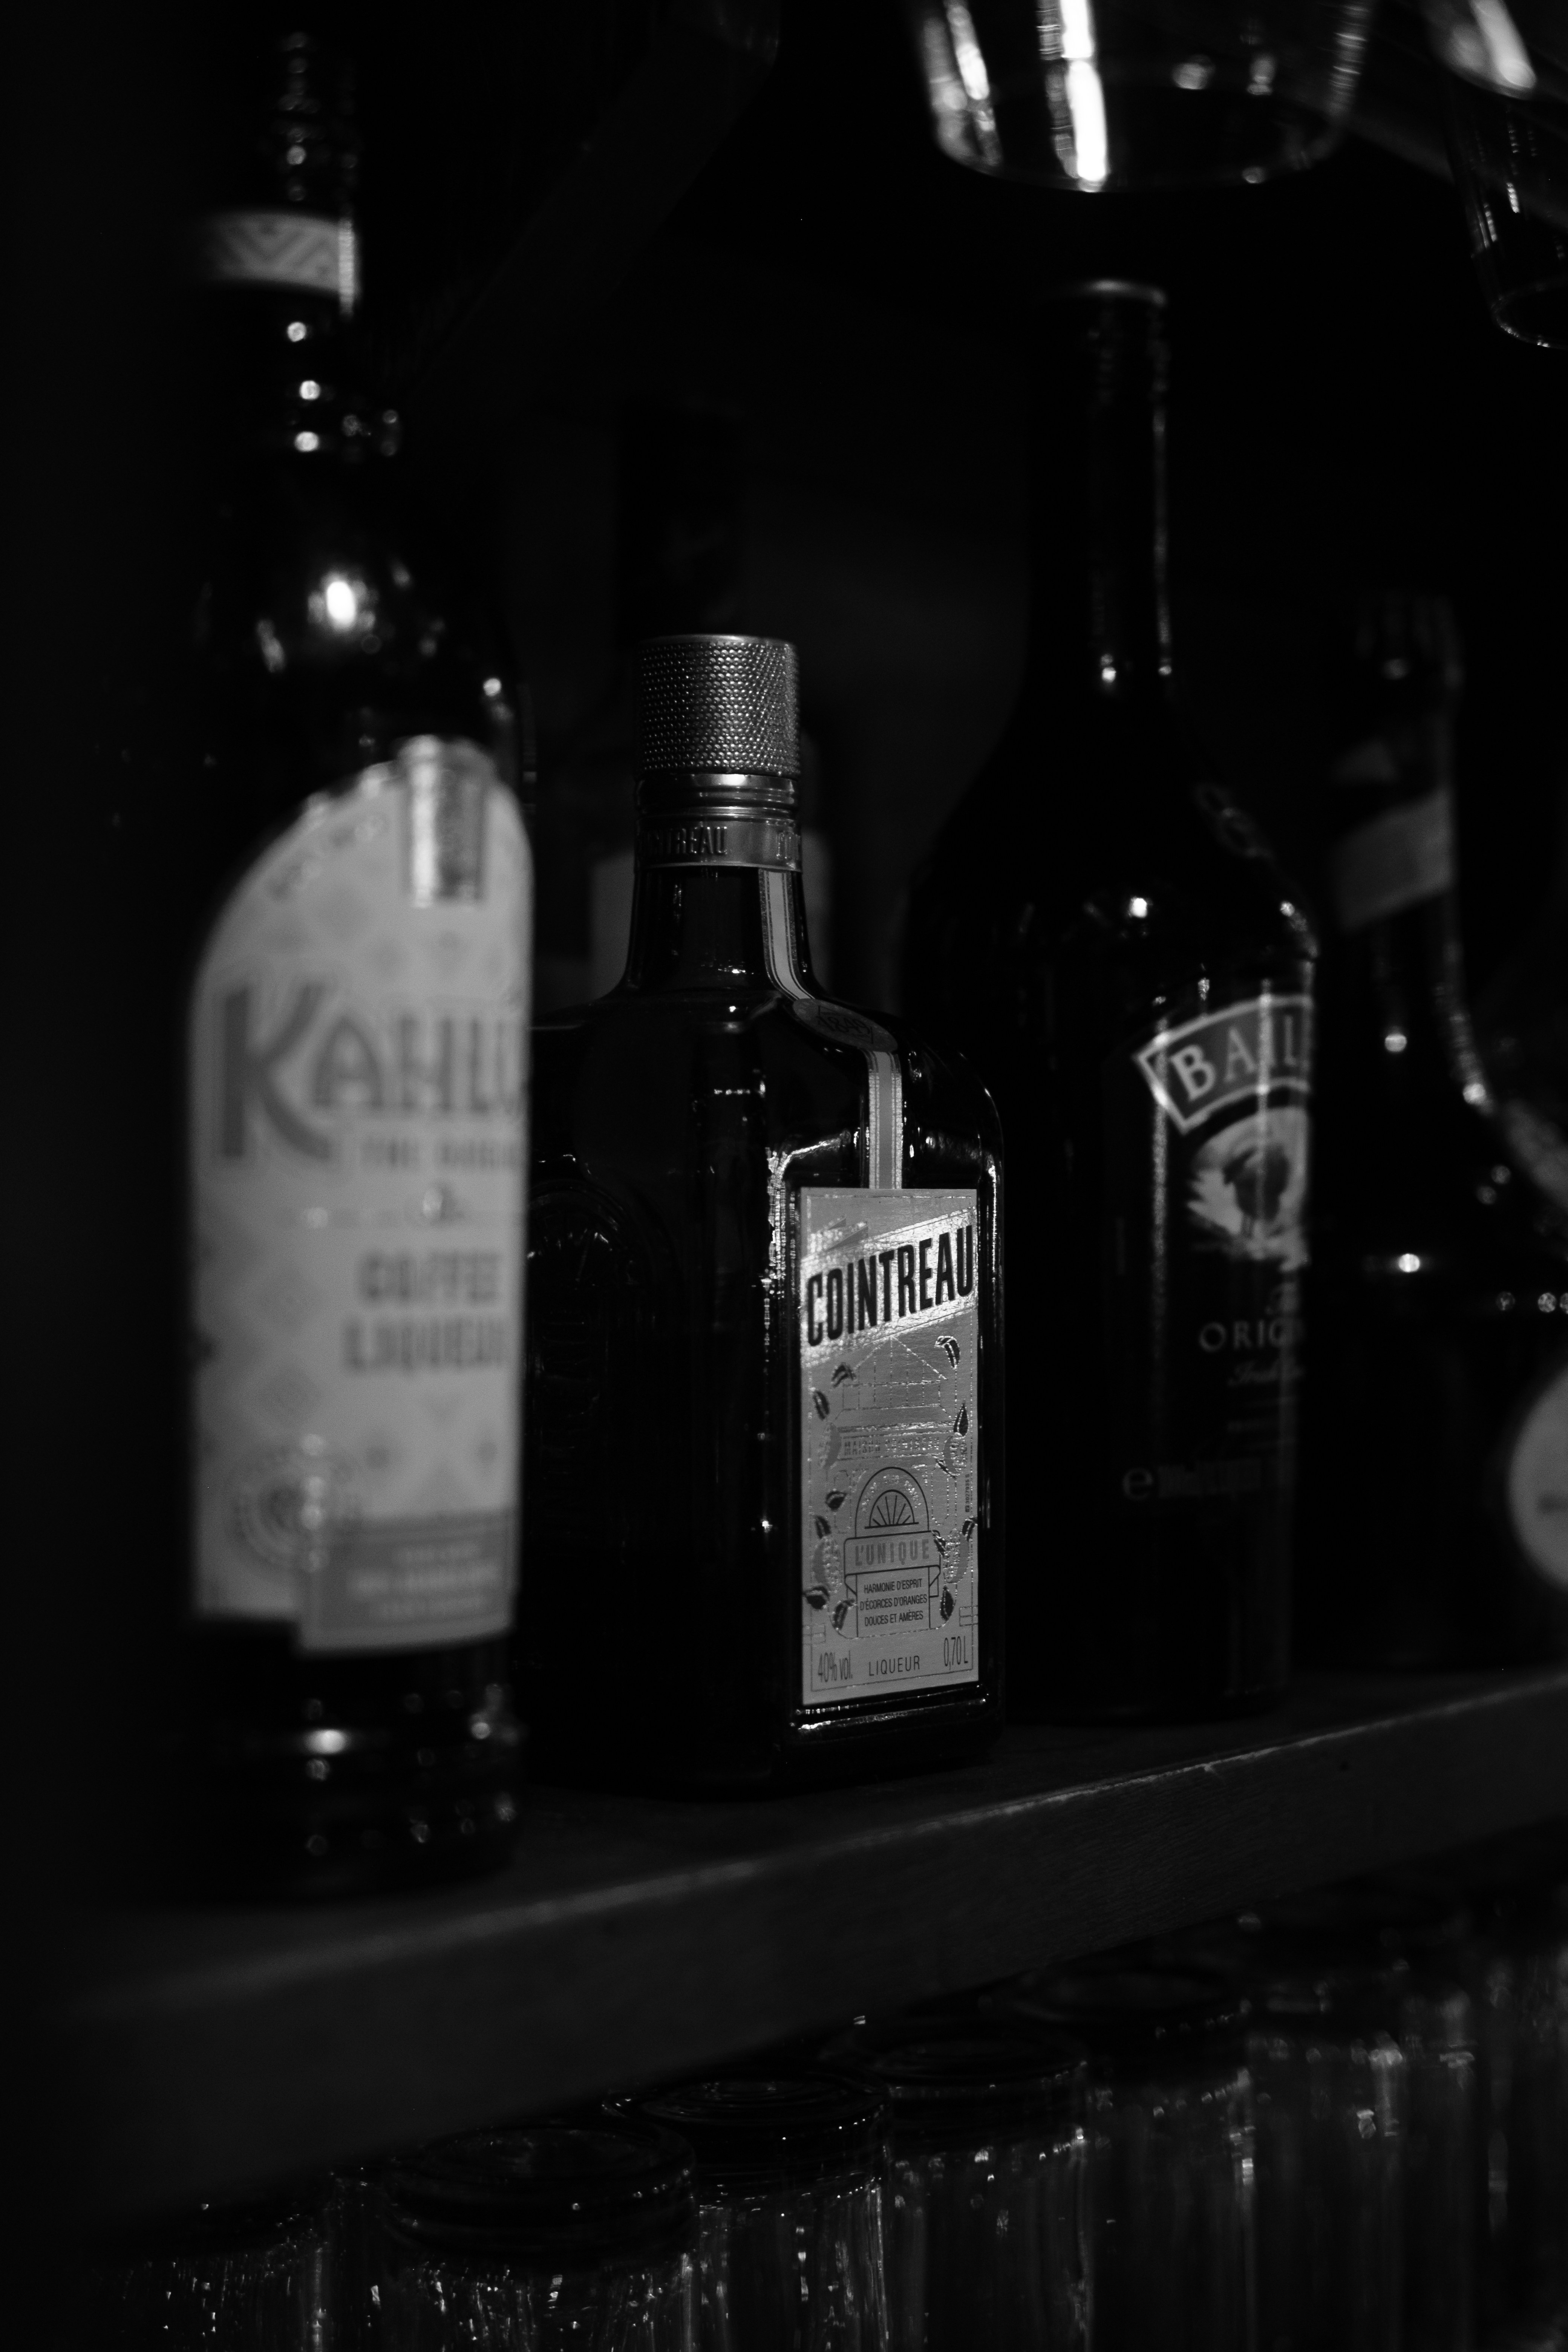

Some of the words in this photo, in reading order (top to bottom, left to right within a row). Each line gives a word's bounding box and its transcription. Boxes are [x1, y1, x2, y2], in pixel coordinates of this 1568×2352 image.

[816, 1015, 871, 1034] 1849
[808, 1225, 972, 1346] COINTREAU
[855, 1539, 929, 1566] L'UNIQUE
[864, 1581, 895, 1594] HARMONIE
[897, 1578, 922, 1590] D'ESPRIT
[860, 1598, 893, 1611] D'ÉCORCES
[894, 1594, 927, 1607] D'ORANGES
[864, 1615, 889, 1626] DOUCES
[890, 1614, 897, 1624] ET
[898, 1609, 923, 1622] AMÈRES
[817, 1652, 838, 1683] 40%
[868, 1655, 920, 1676] LIQUEUR
